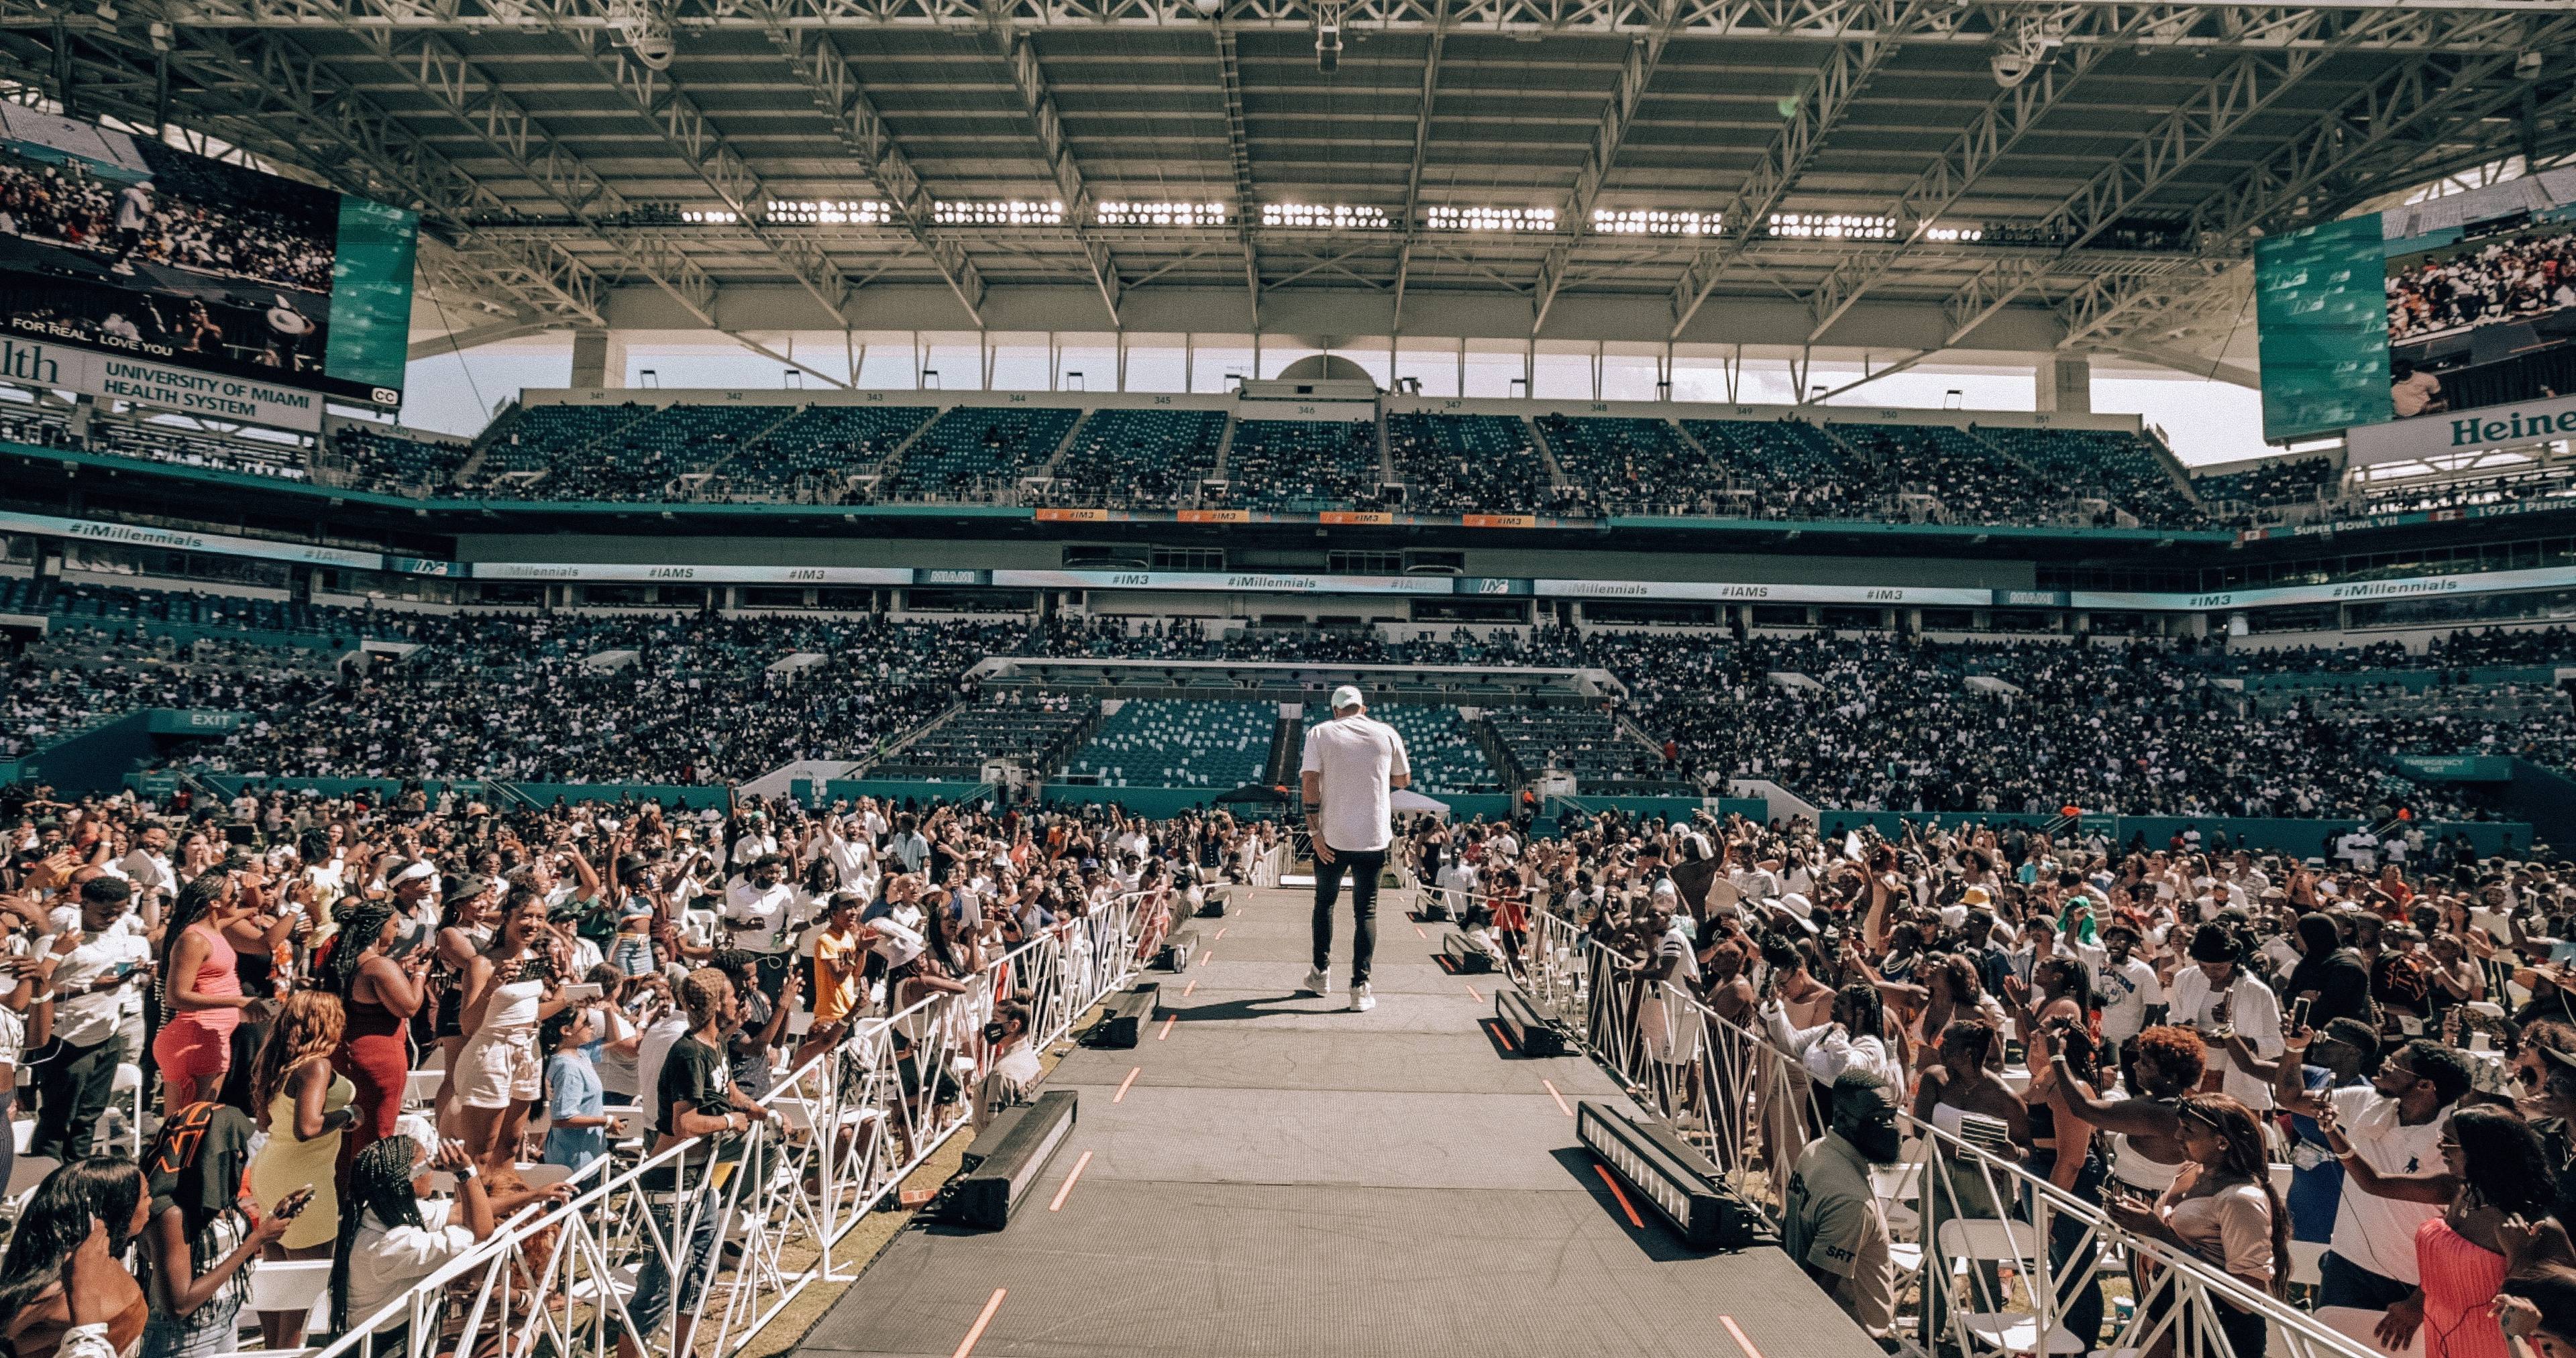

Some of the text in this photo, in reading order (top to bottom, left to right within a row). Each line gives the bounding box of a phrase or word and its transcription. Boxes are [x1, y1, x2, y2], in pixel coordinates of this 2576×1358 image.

[12, 318, 46, 333] FOR
[100, 335, 140, 350] LOVE
[142, 343, 173, 356] YOU
[106, 361, 310, 409] UNIVERSITY OF MIAMI
[105, 380, 256, 416] HEALTH SYSTEM
[374, 390, 394, 402] CC
[727, 392, 743, 400] 342
[867, 393, 883, 401] 343
[1010, 394, 1026, 402] 344
[1155, 396, 1171, 404] 345
[1299, 406, 1315, 414] 346
[1591, 404, 1607, 412] 348
[1736, 407, 1752, 416] 349
[2451, 411, 2576, 447] Heine
[1212, 512, 1236, 520] #IM3
[2479, 503, 2520, 517] 1972
[1354, 514, 1379, 523] #IM3
[1497, 516, 1521, 525] #IM3
[2335, 520, 2374, 532] BOWL
[2377, 516, 2398, 527] VII
[70, 522, 202, 548] #iMillennials
[649, 568, 694, 578] #IAMS
[789, 569, 825, 580] #IM3
[1112, 574, 1149, 585] #IM3
[1228, 575, 1316, 589] #iMillennials
[1721, 586, 1768, 598] #IAMS
[1866, 589, 1903, 600] #IM3
[2189, 579, 2458, 608] #IM3 #iMillennials
[191, 714, 231, 726] EXIT
[1825, 1245, 1856, 1263] SRT
